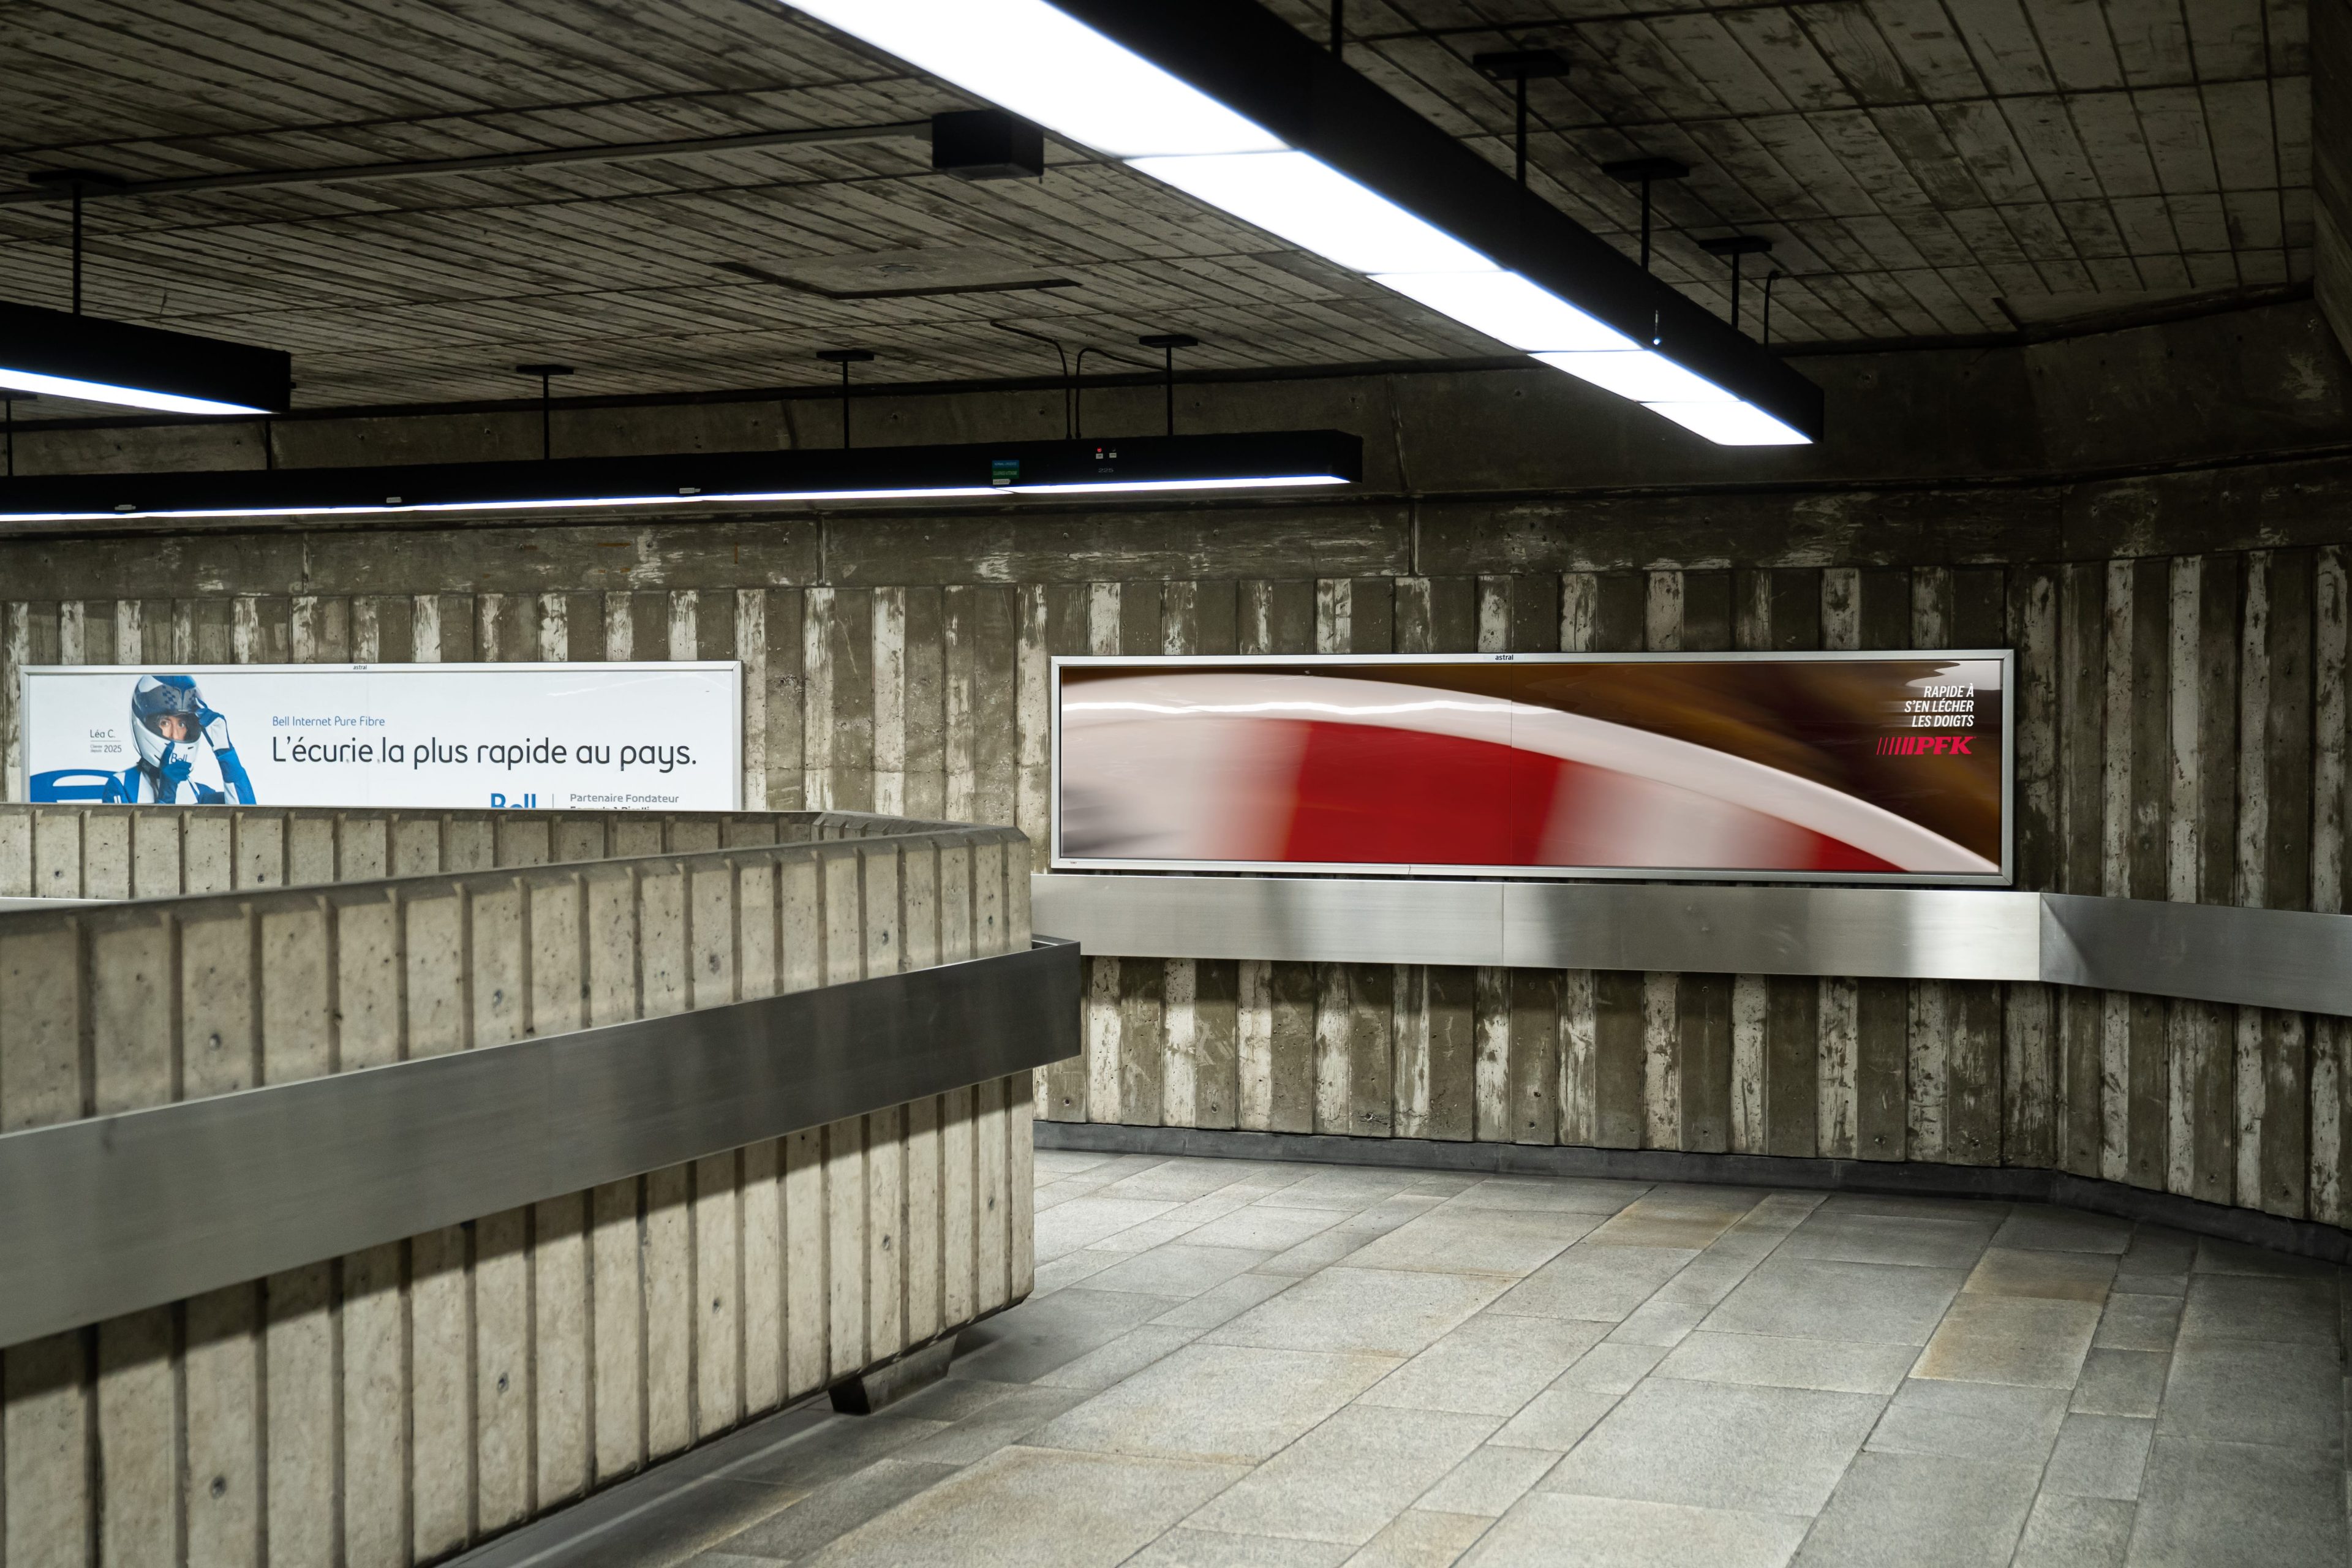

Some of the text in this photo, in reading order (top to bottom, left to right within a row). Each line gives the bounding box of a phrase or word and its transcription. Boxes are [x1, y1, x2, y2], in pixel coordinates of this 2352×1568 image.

[1923, 682, 1974, 698] RAPIDE À
[1904, 698, 1974, 713] S'EN LÉCHER
[273, 716, 385, 726] Bell Internet Pure Fibre
[1911, 714, 1975, 728] LES DOIGTS
[89, 729, 105, 738] Léa
[104, 744, 122, 753] 2025
[1913, 736, 1974, 755] PFK
[273, 736, 696, 774] L'écurie la plus rapide au pays.
[570, 793, 679, 803] Partenaire Fondateur
